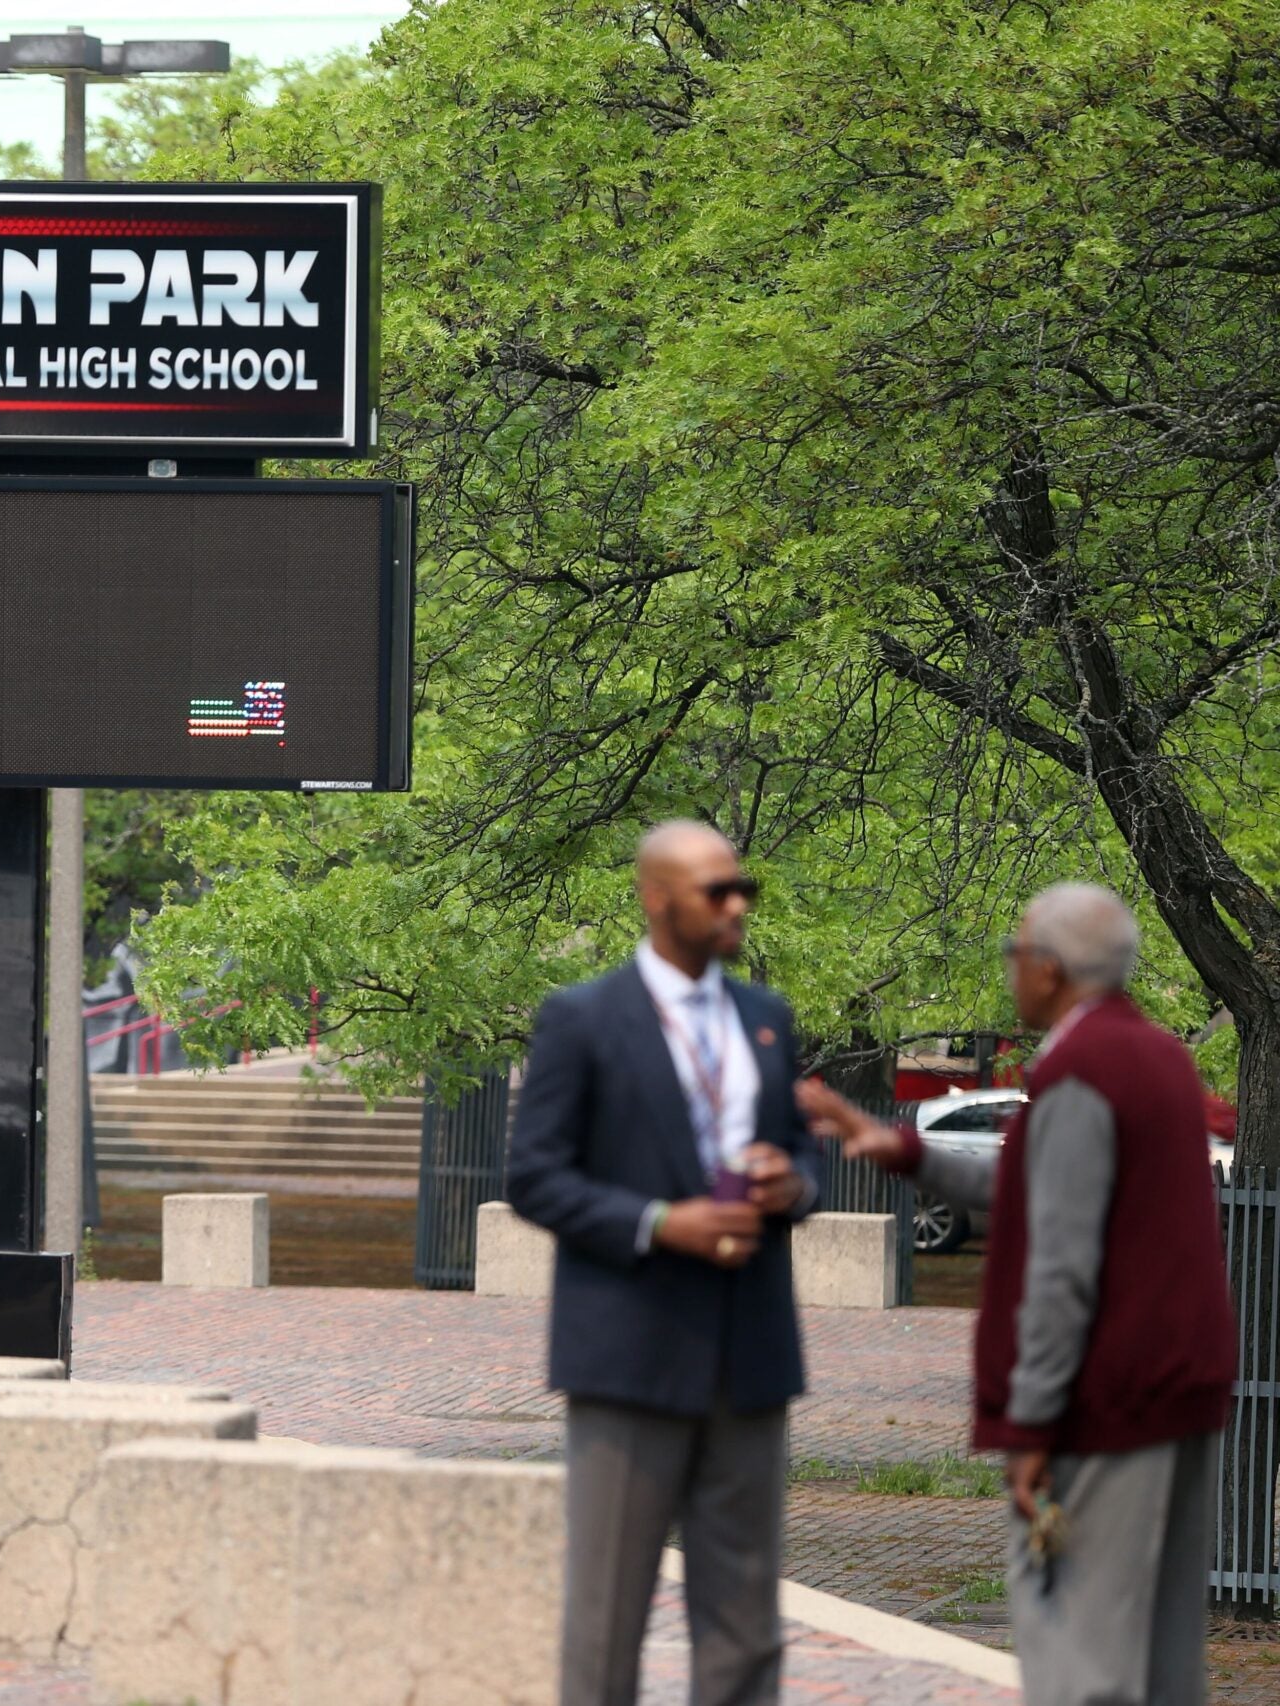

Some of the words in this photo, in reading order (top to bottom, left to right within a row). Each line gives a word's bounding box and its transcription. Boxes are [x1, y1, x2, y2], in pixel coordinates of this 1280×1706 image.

[89, 249, 319, 327] PARK
[39, 346, 137, 389] HIGH
[148, 347, 318, 391] SCHOOL
[301, 780, 373, 789] STEWARTSIGNS.COM
